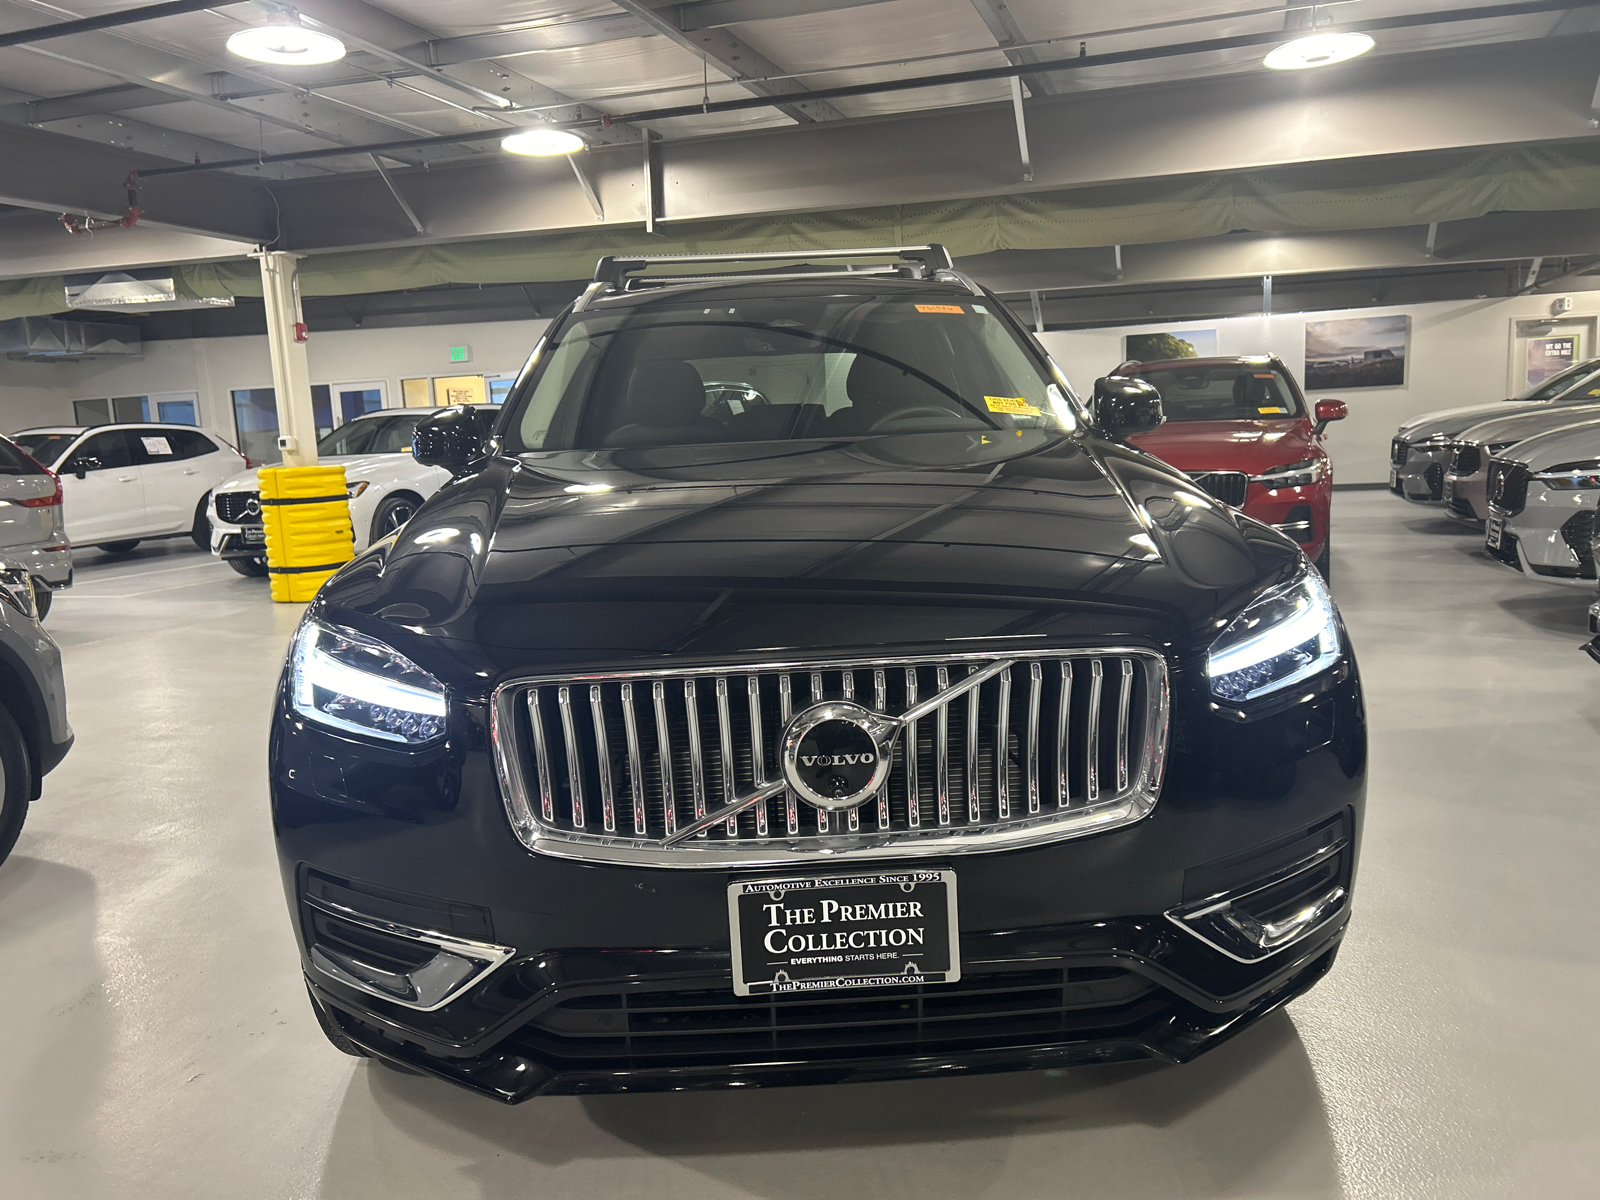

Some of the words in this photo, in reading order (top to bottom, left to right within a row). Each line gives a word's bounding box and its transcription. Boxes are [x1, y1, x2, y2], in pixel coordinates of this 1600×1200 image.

[450, 346, 465, 361] EXIT
[800, 752, 875, 767] VOLVO
[745, 881, 812, 893] AUTOMOTIVE
[814, 875, 877, 888] EXCELLENCE
[879, 874, 909, 884] SINCE
[912, 872, 941, 882] 1995
[762, 902, 816, 927] THE
[820, 900, 924, 924] PREMIER
[764, 927, 925, 954] COLLECTION
[790, 954, 844, 966] EVERYTHING
[845, 953, 875, 962] STARTS
[876, 951, 900, 960] HERE.
[769, 974, 925, 992] THEPREMIERCOLLECTION.COM
